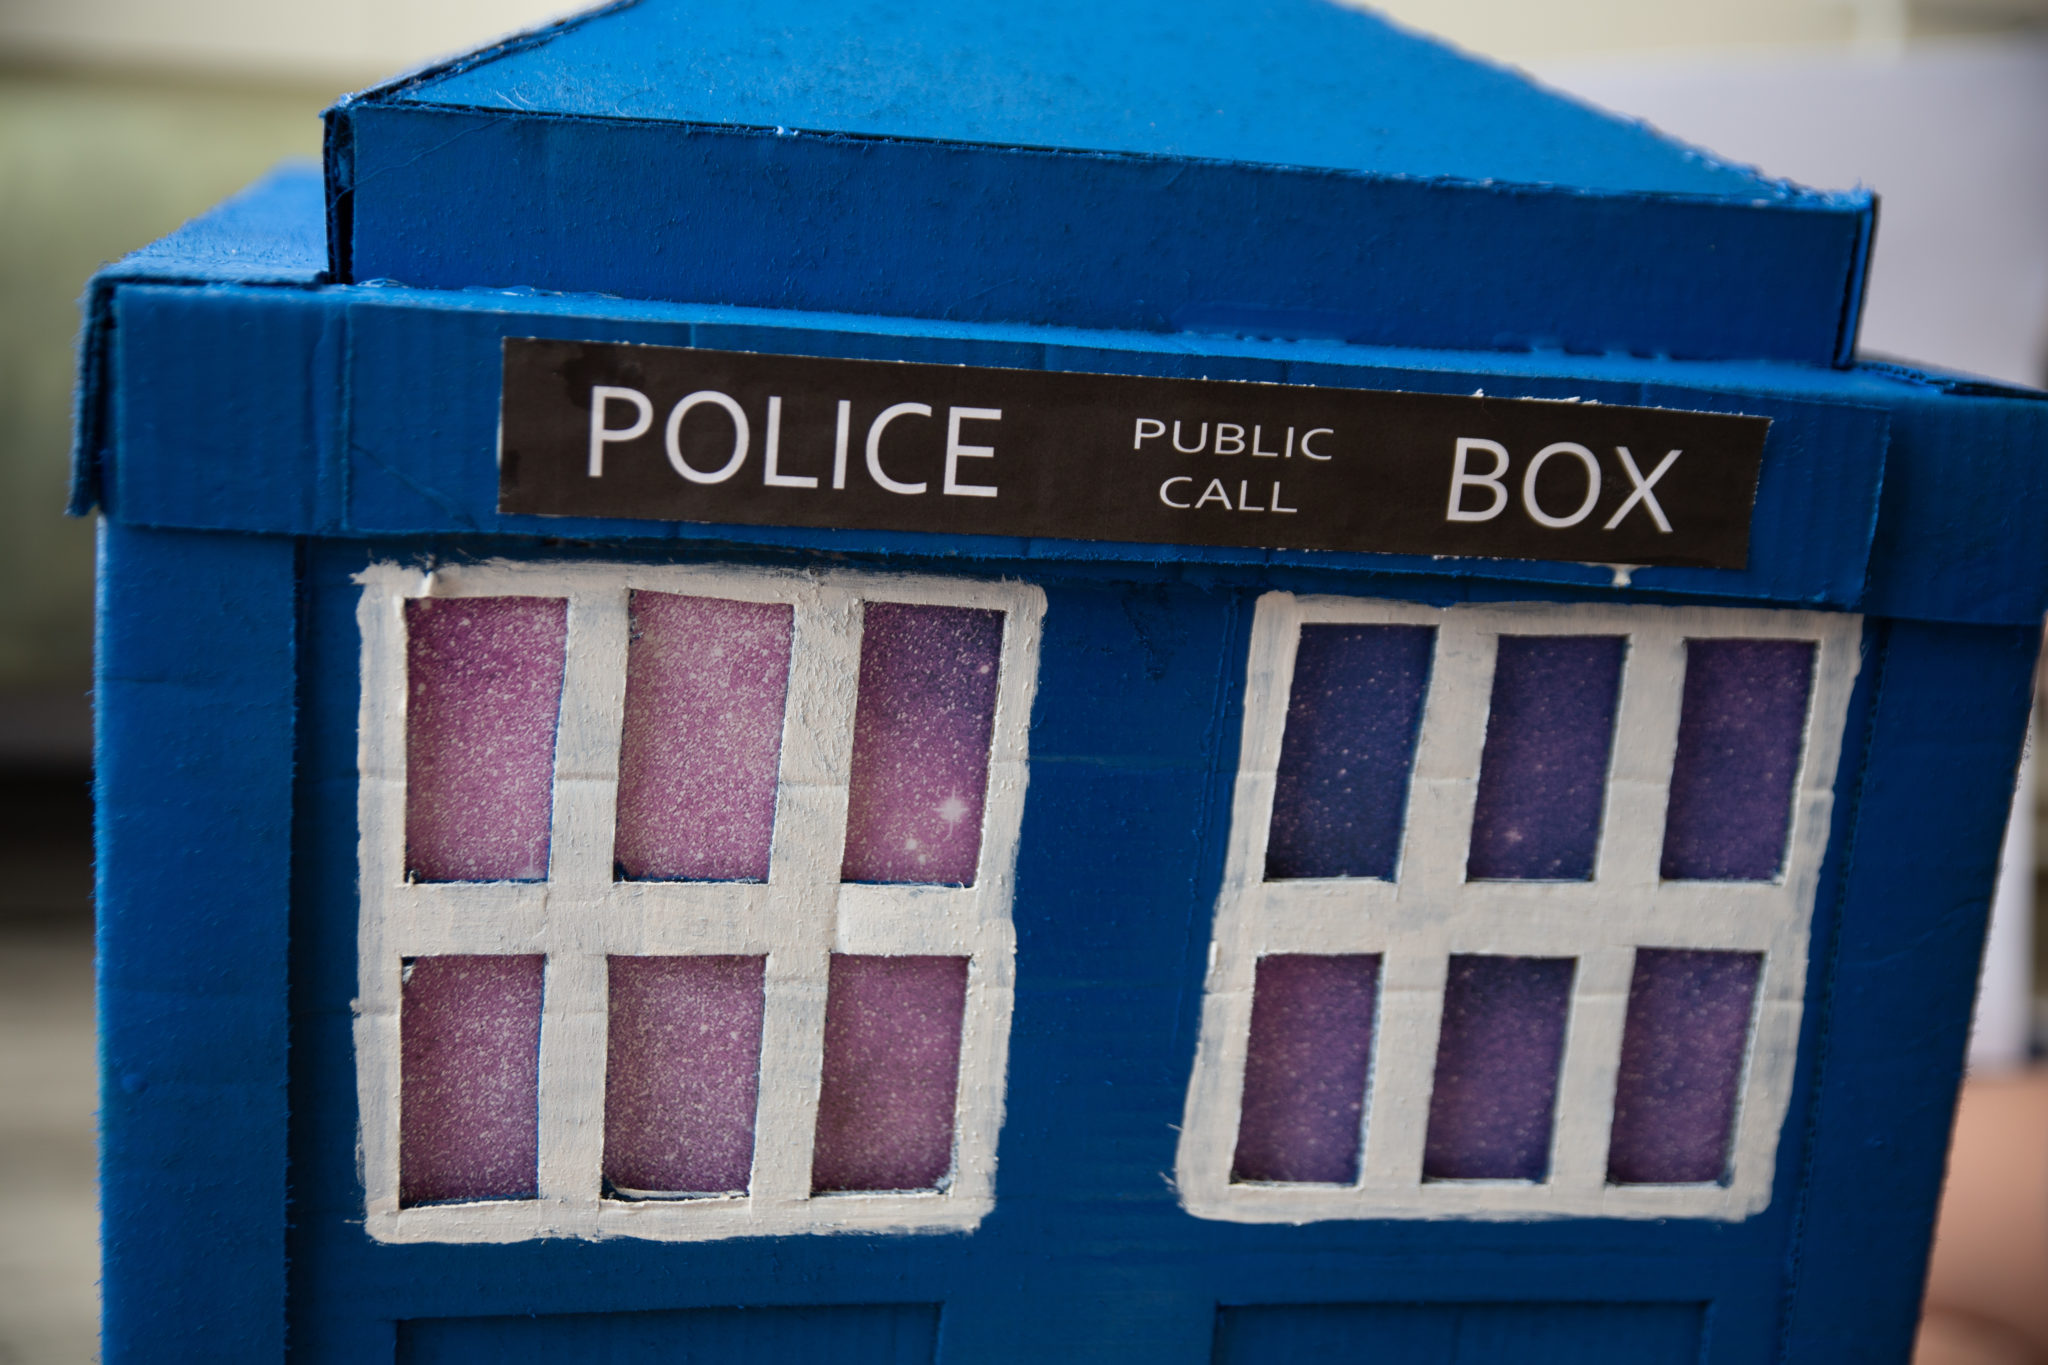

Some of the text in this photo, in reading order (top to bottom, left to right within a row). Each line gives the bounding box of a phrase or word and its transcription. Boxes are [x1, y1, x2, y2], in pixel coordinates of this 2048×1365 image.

[589, 385, 1002, 498] POLICE
[1133, 418, 1335, 461] PUBLIC
[1158, 476, 1298, 513] CALL
[1446, 437, 1682, 532] BOX
